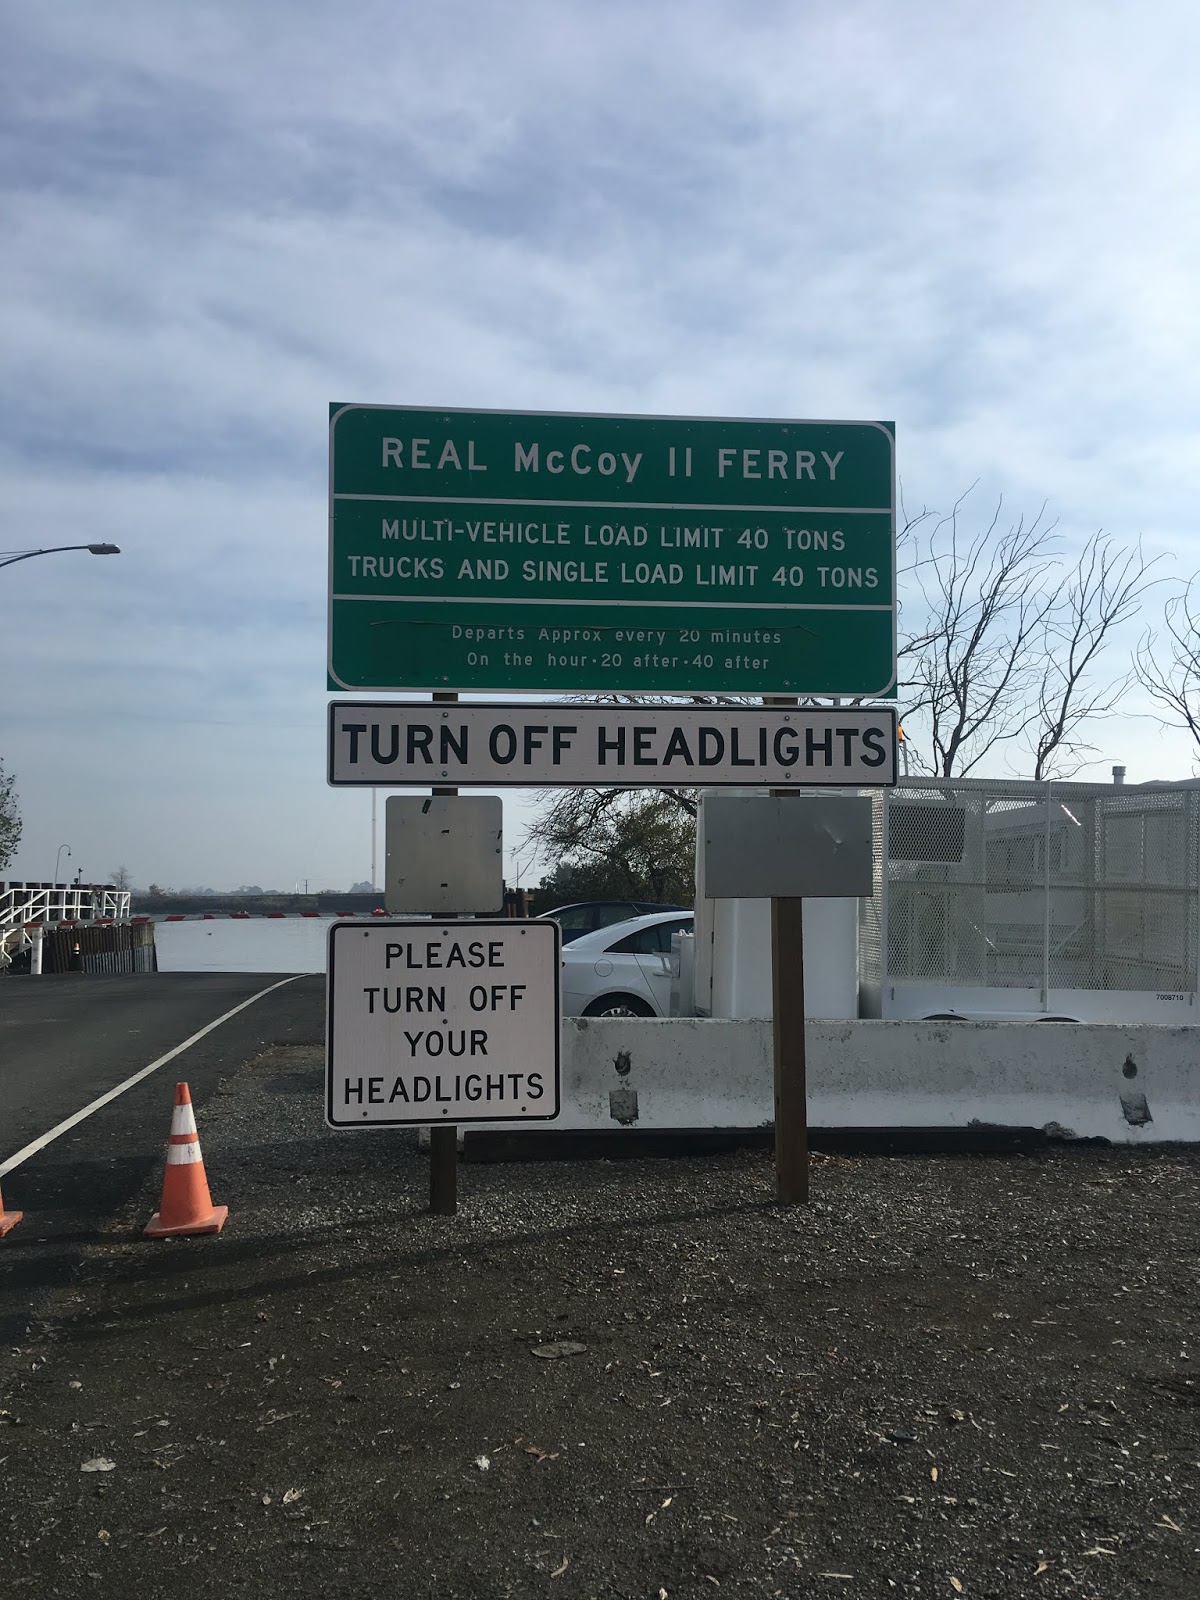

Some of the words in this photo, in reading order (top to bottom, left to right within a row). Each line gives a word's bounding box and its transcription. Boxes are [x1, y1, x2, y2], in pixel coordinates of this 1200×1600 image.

[381, 437, 487, 473] REAL
[515, 443, 643, 482] McCoy
[719, 448, 845, 480] FERRY
[381, 519, 571, 545] MULTI-VEHICLE
[585, 525, 647, 547] LOAD
[661, 527, 723, 548] LIMIT
[737, 529, 768, 550] 40
[785, 529, 845, 551] TONS
[348, 556, 445, 580] TRUCKS
[458, 559, 509, 581] AND
[522, 560, 608, 583] SINGLE
[621, 563, 684, 585] LOAD
[696, 564, 759, 586] LIMIT
[772, 566, 804, 587] 40
[818, 566, 879, 588] TONS
[452, 625, 525, 642] Departs
[538, 627, 601, 643] Approx
[615, 630, 665, 645] every
[679, 630, 700, 642] 20
[711, 630, 781, 643] minutes
[467, 652, 489, 665] On
[504, 652, 533, 665] the
[724, 656, 769, 669] after
[342, 724, 468, 765] TURN
[490, 725, 578, 765] OFF
[598, 727, 887, 768] HEADLIGHTS
[386, 942, 504, 969] PLEASE
[364, 986, 446, 1013] TURN
[470, 985, 526, 1012] OFF
[404, 1030, 488, 1057] YOUR
[345, 1073, 544, 1104] HEADLIGHTS
